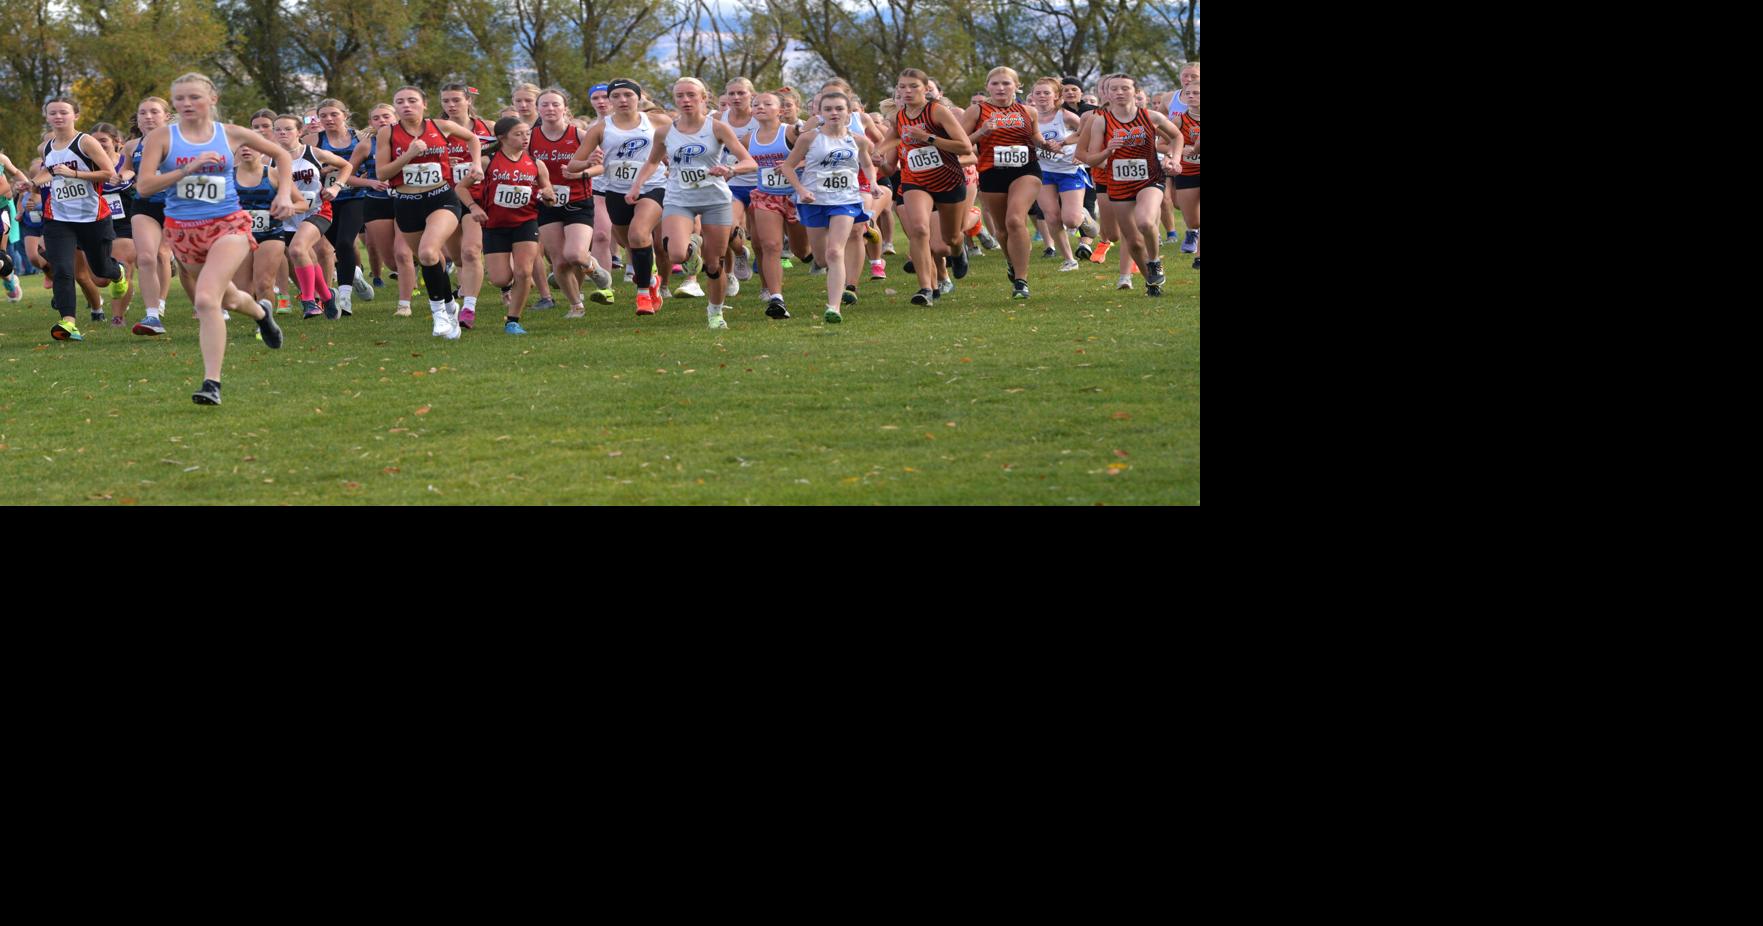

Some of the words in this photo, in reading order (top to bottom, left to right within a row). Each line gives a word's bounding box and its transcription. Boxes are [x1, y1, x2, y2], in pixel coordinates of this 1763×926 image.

[534, 149, 549, 160] Soda
[550, 150, 575, 162] Spring
[908, 151, 939, 168] 1055
[996, 152, 1027, 163] 1058
[492, 168, 510, 181] Soda
[615, 167, 638, 180] 467
[1116, 164, 1146, 177] 1035
[406, 170, 440, 185] 2473
[823, 176, 848, 188] 469
[56, 184, 86, 200] 2906
[185, 183, 218, 199] 870
[428, 184, 450, 197] NIKE
[498, 190, 529, 205] 1085
